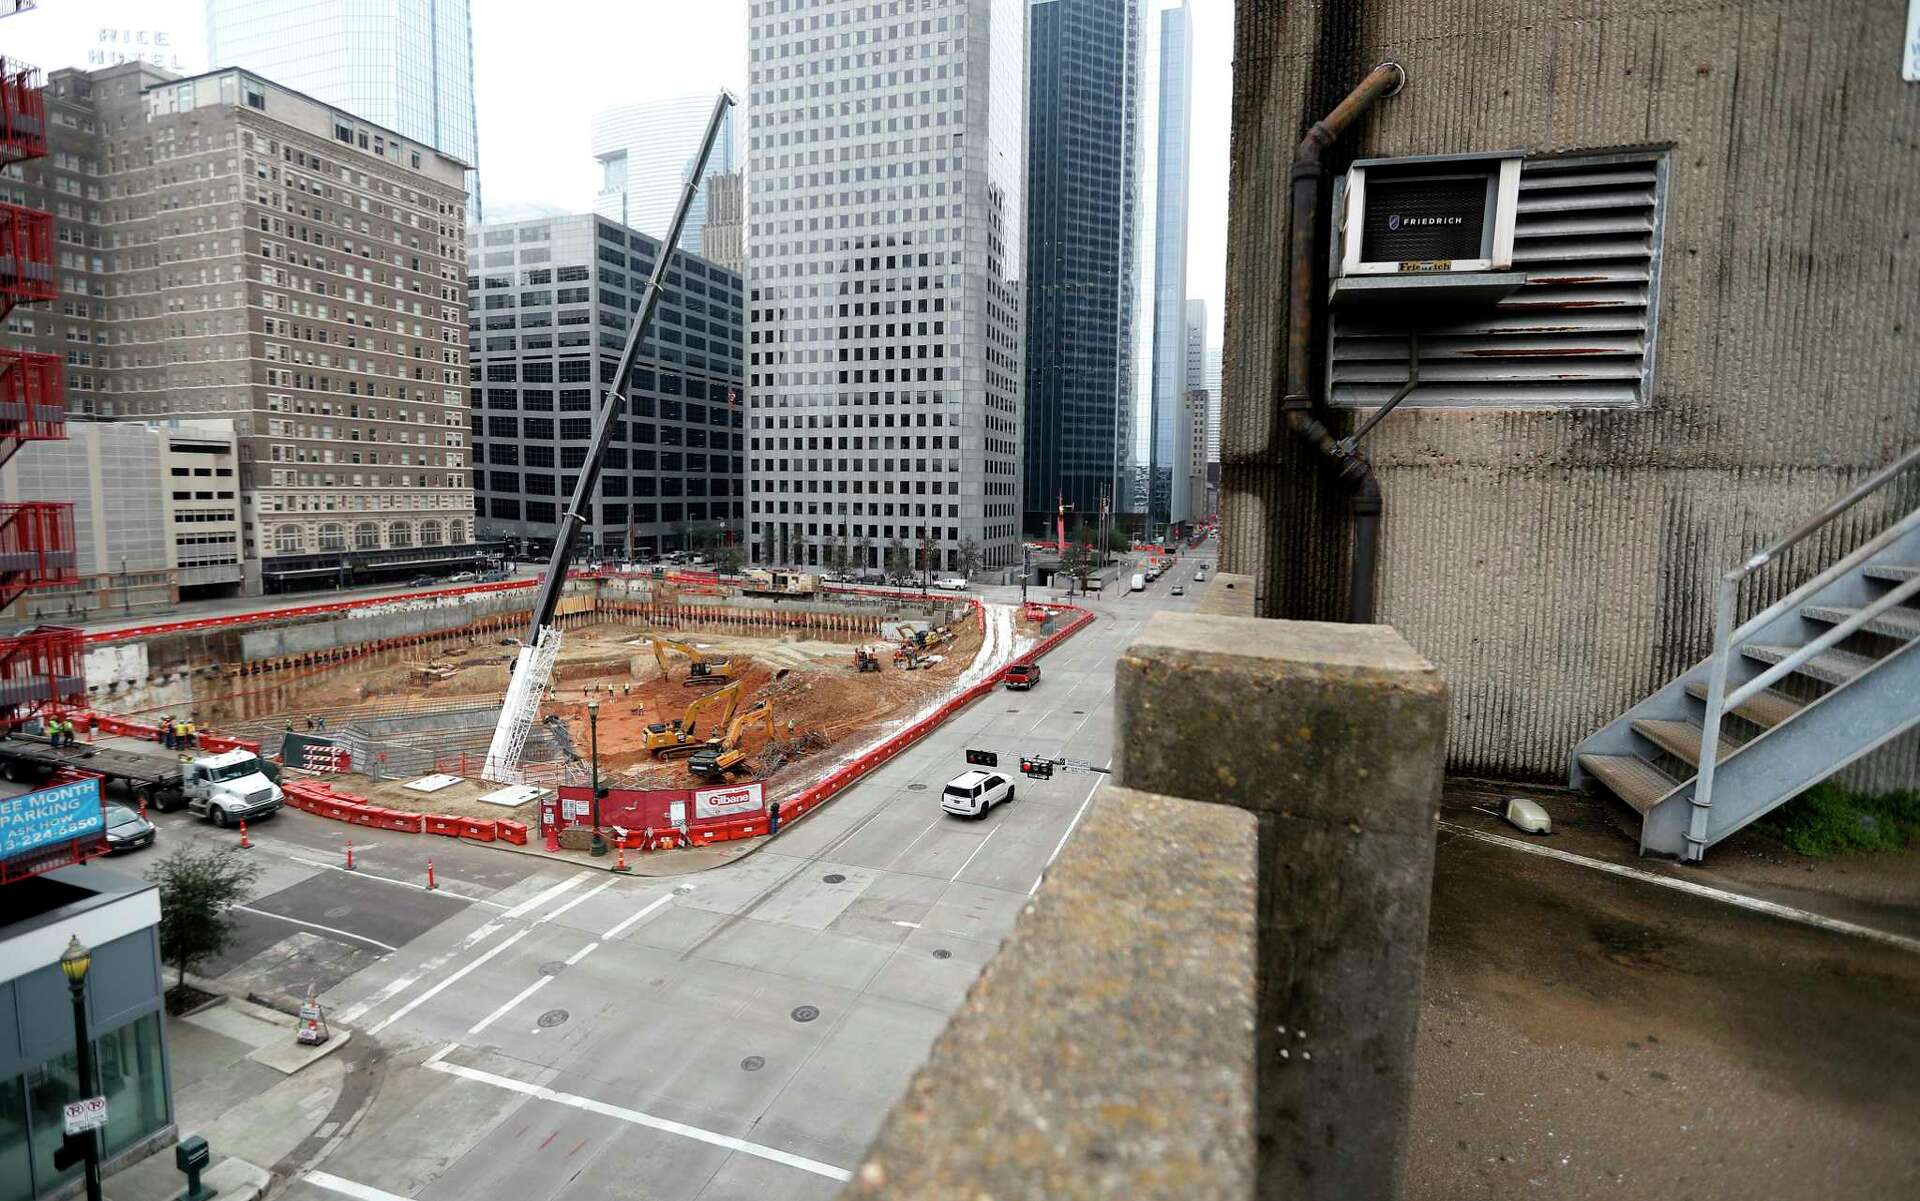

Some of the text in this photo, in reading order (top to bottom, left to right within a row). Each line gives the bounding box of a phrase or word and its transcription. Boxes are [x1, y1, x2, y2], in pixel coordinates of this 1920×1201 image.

[98, 28, 169, 46] RICE
[88, 48, 185, 70] HOTEL
[1403, 217, 1462, 226] FRIEDRICH
[29, 781, 96, 807] MONTH
[709, 794, 749, 805] Gilbane
[0, 798, 81, 828] PARKING
[8, 814, 74, 839] ASK HOW
